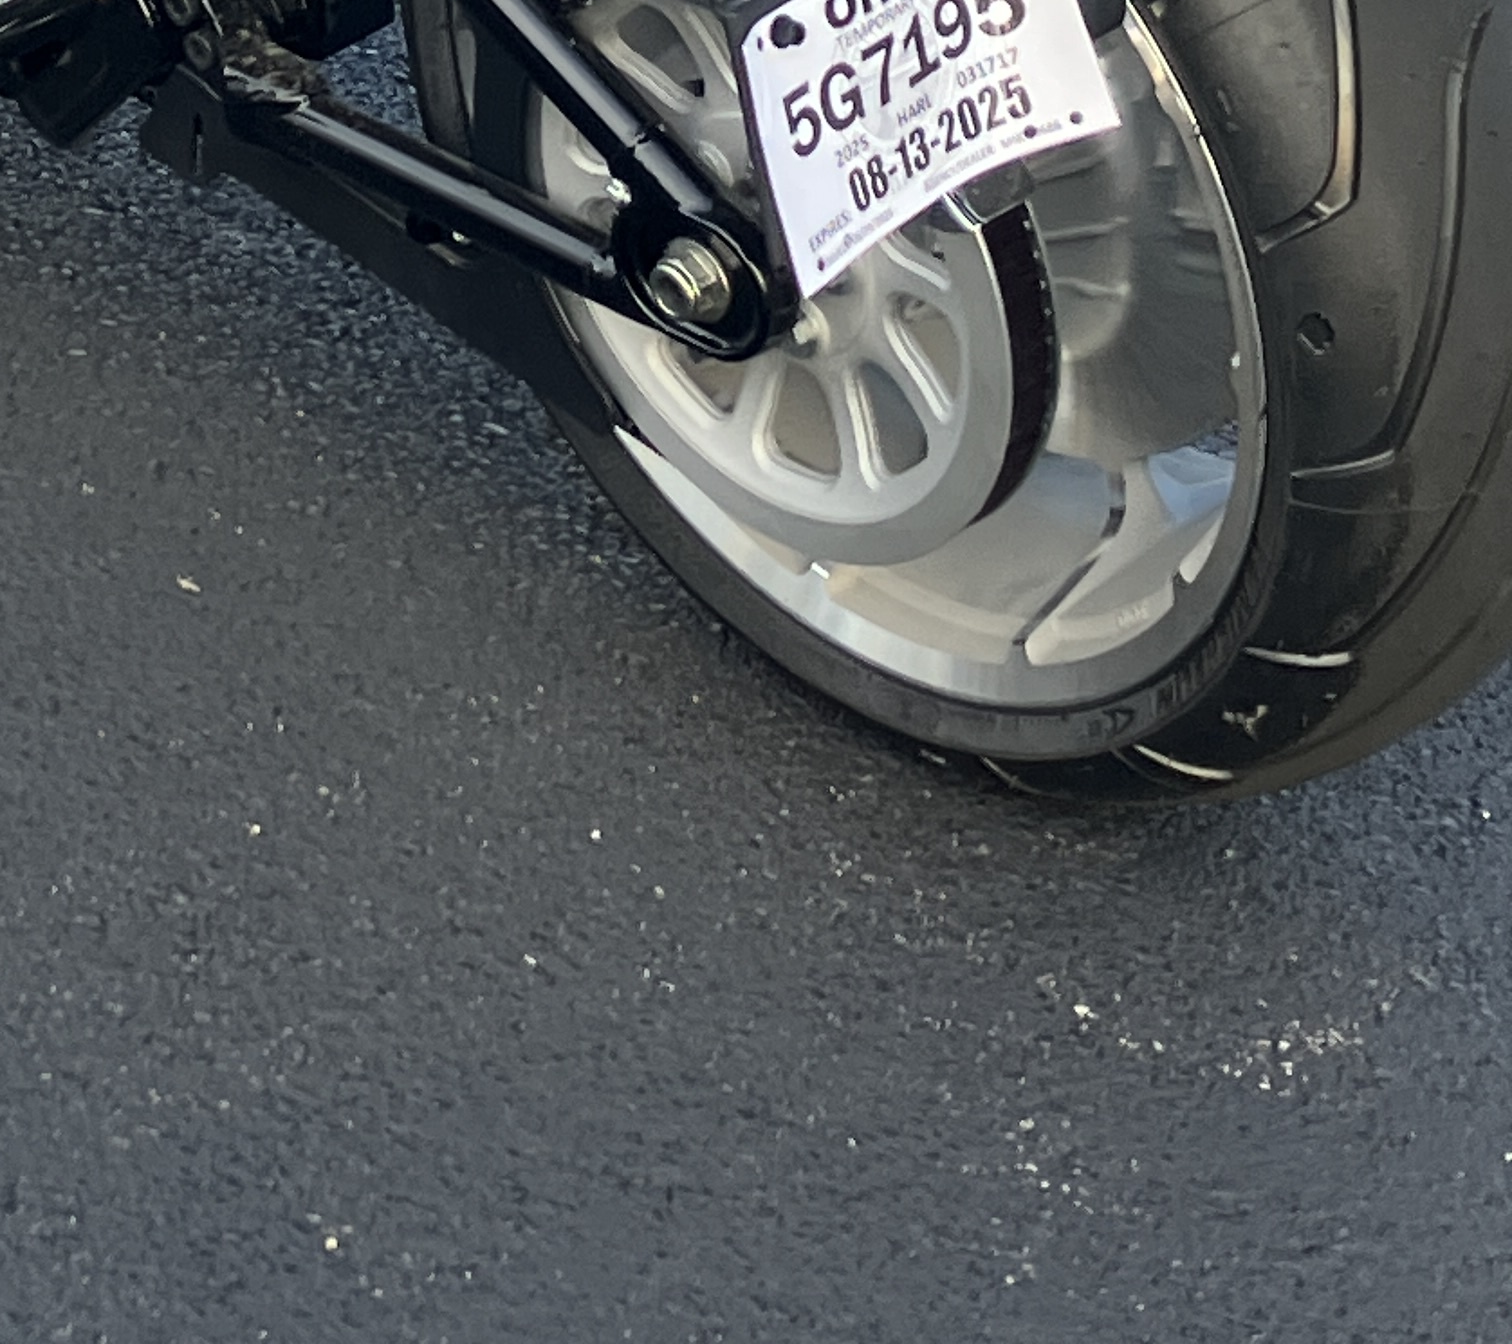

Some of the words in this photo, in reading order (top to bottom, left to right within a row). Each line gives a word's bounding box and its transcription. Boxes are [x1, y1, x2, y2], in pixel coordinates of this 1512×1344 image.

[956, 45, 1019, 89] 031717
[896, 92, 933, 128] HARL
[834, 132, 870, 169] 2025
[848, 73, 1033, 212] 08-13-2025
